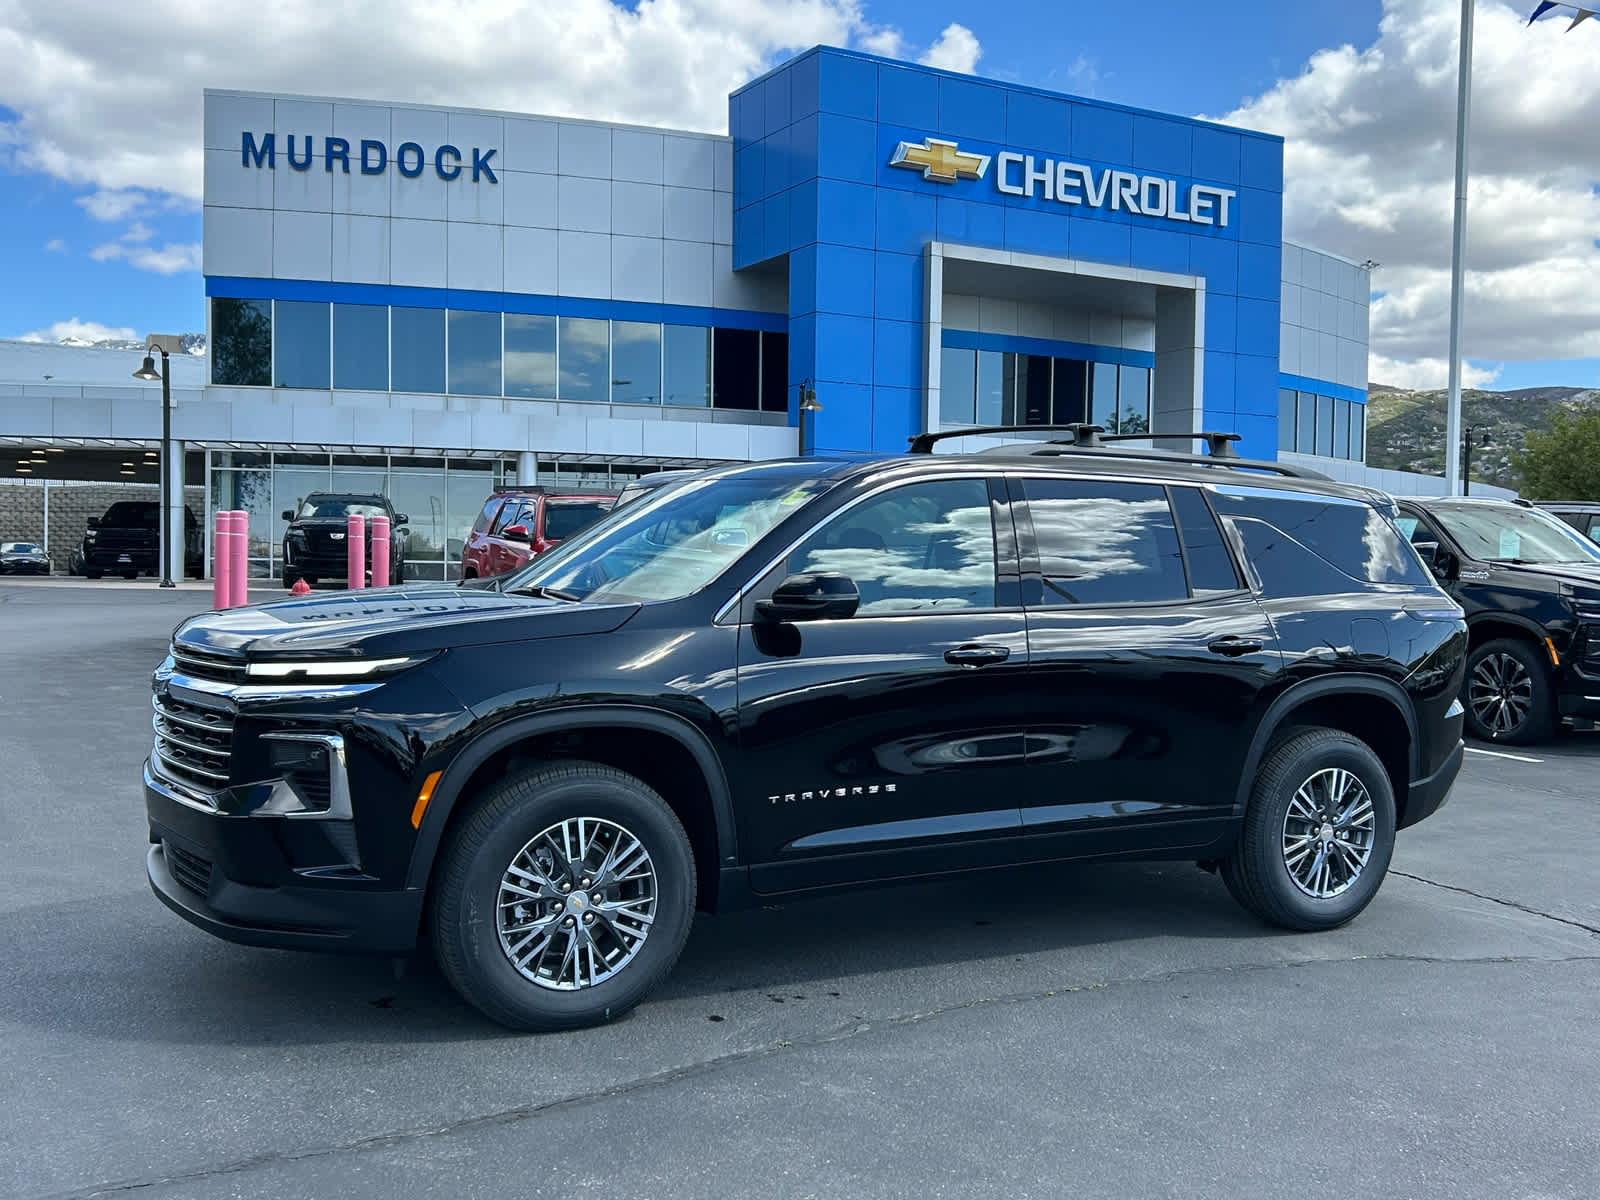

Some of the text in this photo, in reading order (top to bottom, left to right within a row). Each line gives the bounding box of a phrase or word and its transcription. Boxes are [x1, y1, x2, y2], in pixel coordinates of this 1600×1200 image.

[242, 131, 498, 184] MURDOCK
[997, 151, 1236, 226] CHEVROLET
[768, 784, 897, 804] TRAVERSE
